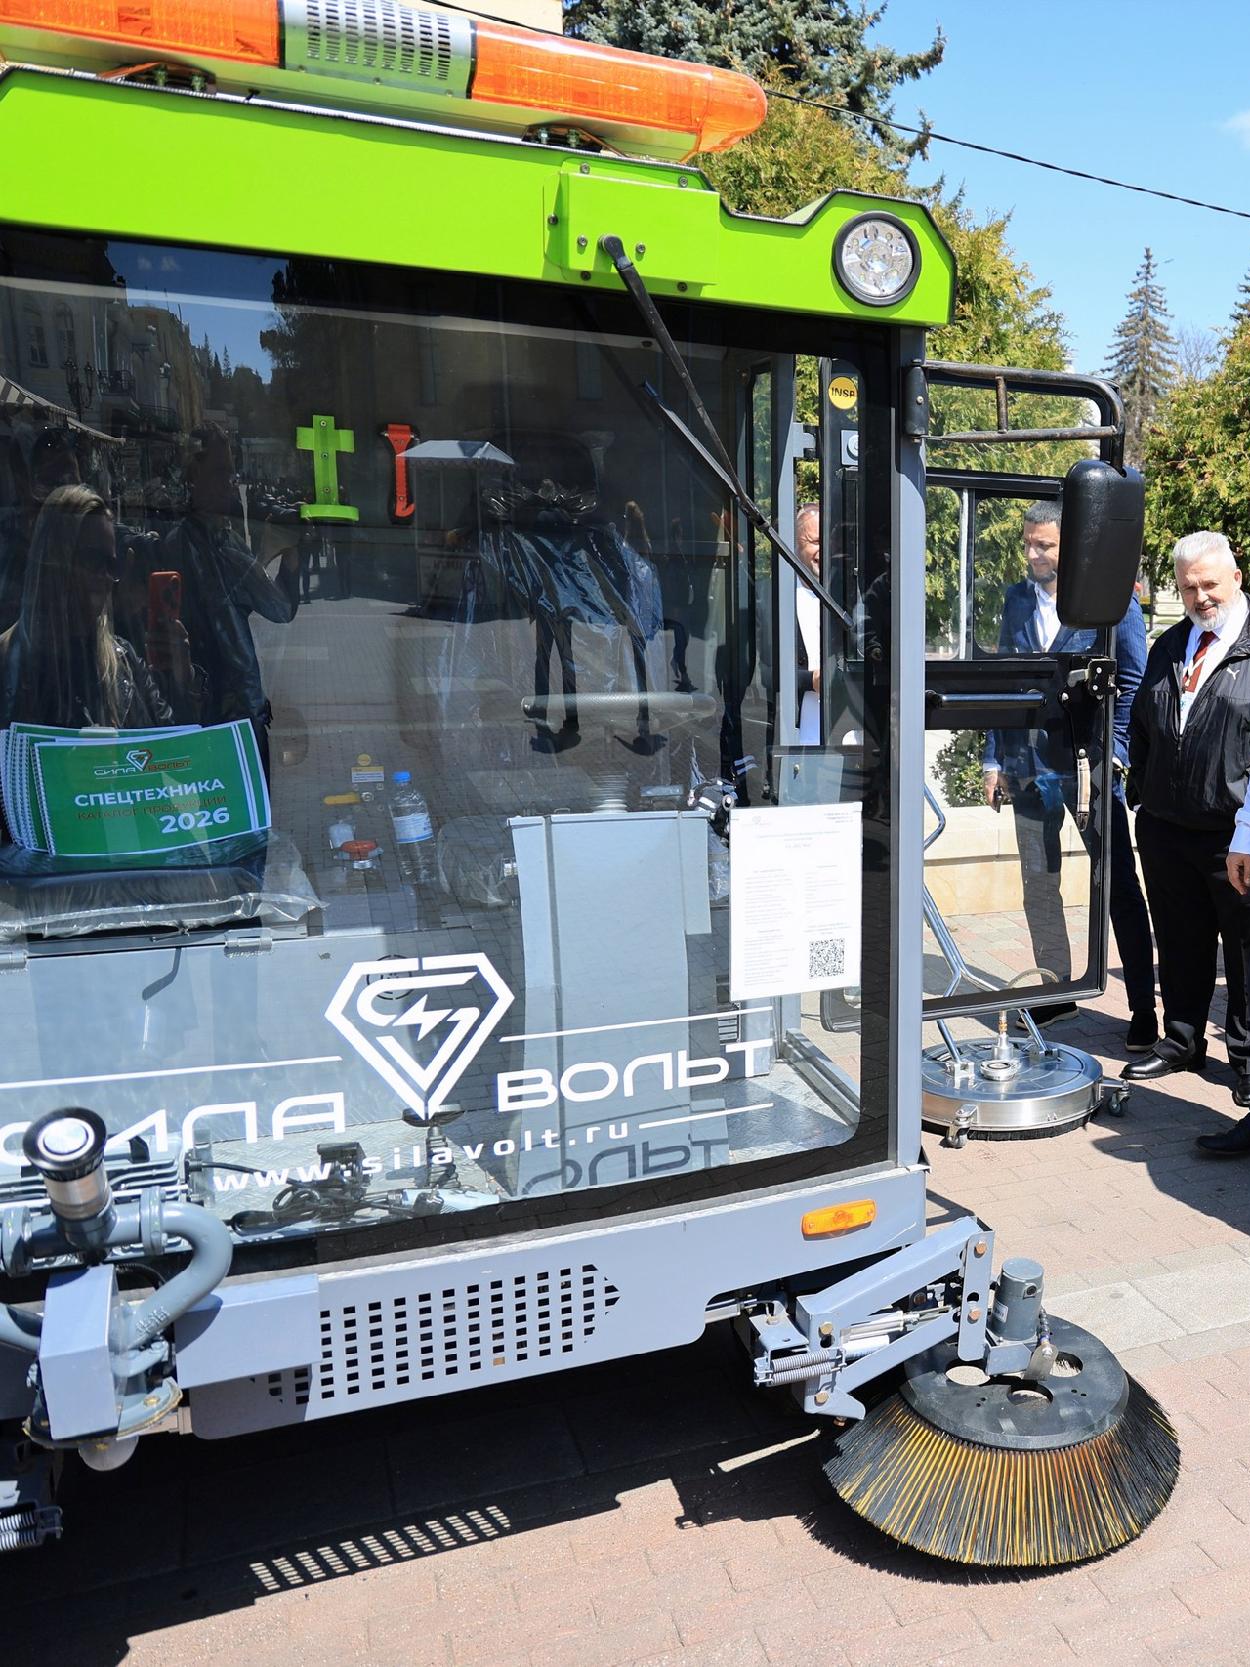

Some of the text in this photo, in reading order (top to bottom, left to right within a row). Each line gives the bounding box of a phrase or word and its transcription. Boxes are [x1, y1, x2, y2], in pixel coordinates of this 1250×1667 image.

[94, 766, 137, 776] СИЛА
[74, 778, 226, 807] СПЕЦТЕХНИКА
[160, 807, 230, 834] 2026
[497, 1038, 774, 1113] ВОЛЬТ
[212, 1122, 629, 1192] www.silavolt.ru
